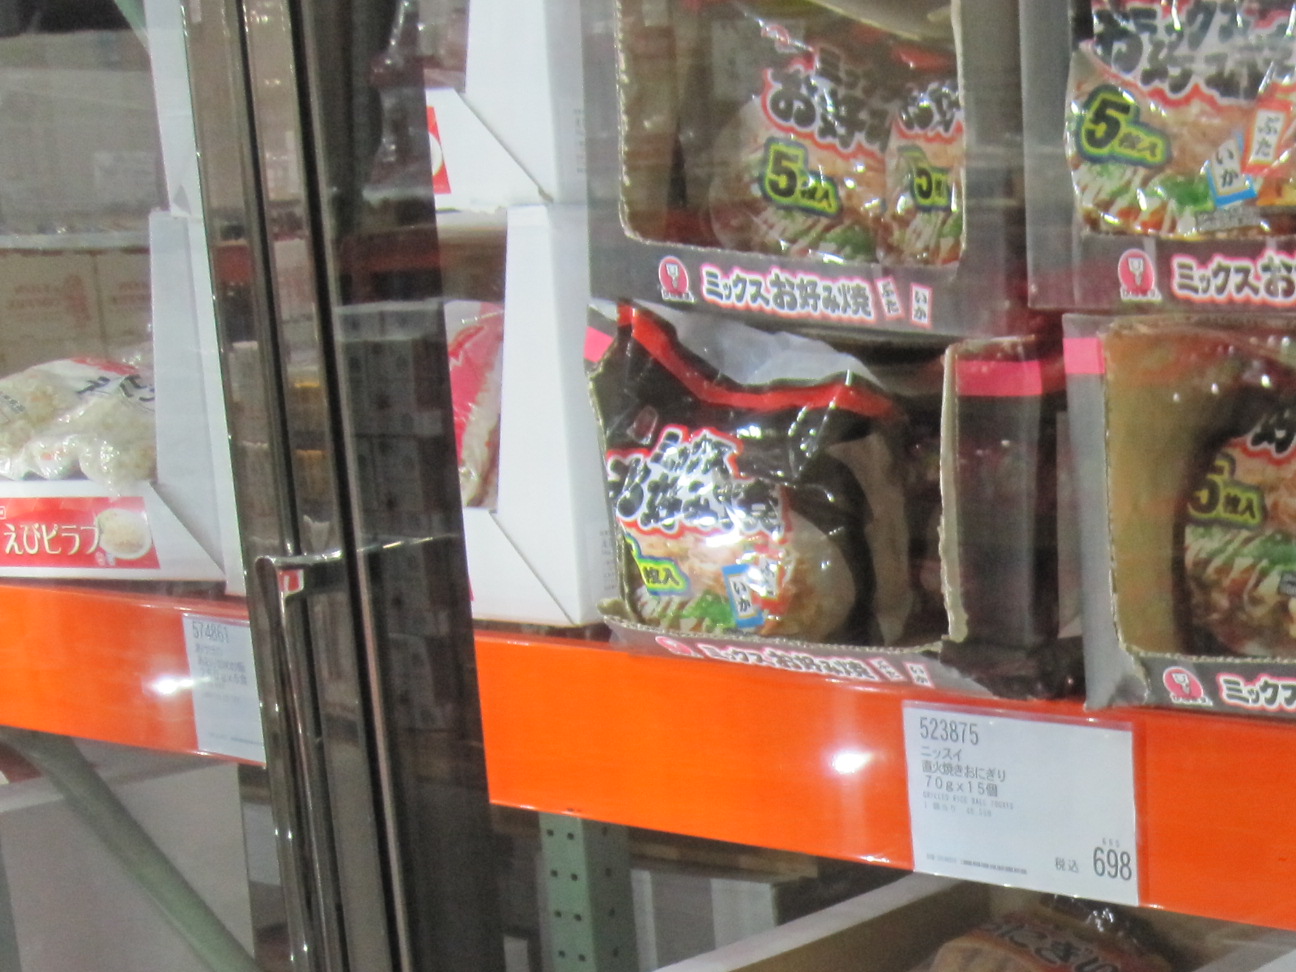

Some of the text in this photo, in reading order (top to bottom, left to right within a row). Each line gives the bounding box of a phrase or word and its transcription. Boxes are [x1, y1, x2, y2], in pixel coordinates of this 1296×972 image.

[1257, 112, 1281, 162] ぶた
[1213, 141, 1240, 189] いか
[704, 267, 873, 318] ミックスお好み焼
[3, 522, 100, 556] えびピラフ
[919, 716, 980, 746] 523875
[921, 745, 963, 762] ニッスイ
[921, 760, 1007, 783] 直火焼きおにぎり
[1055, 856, 1080, 874] 税込
[1093, 846, 1133, 882] 698
